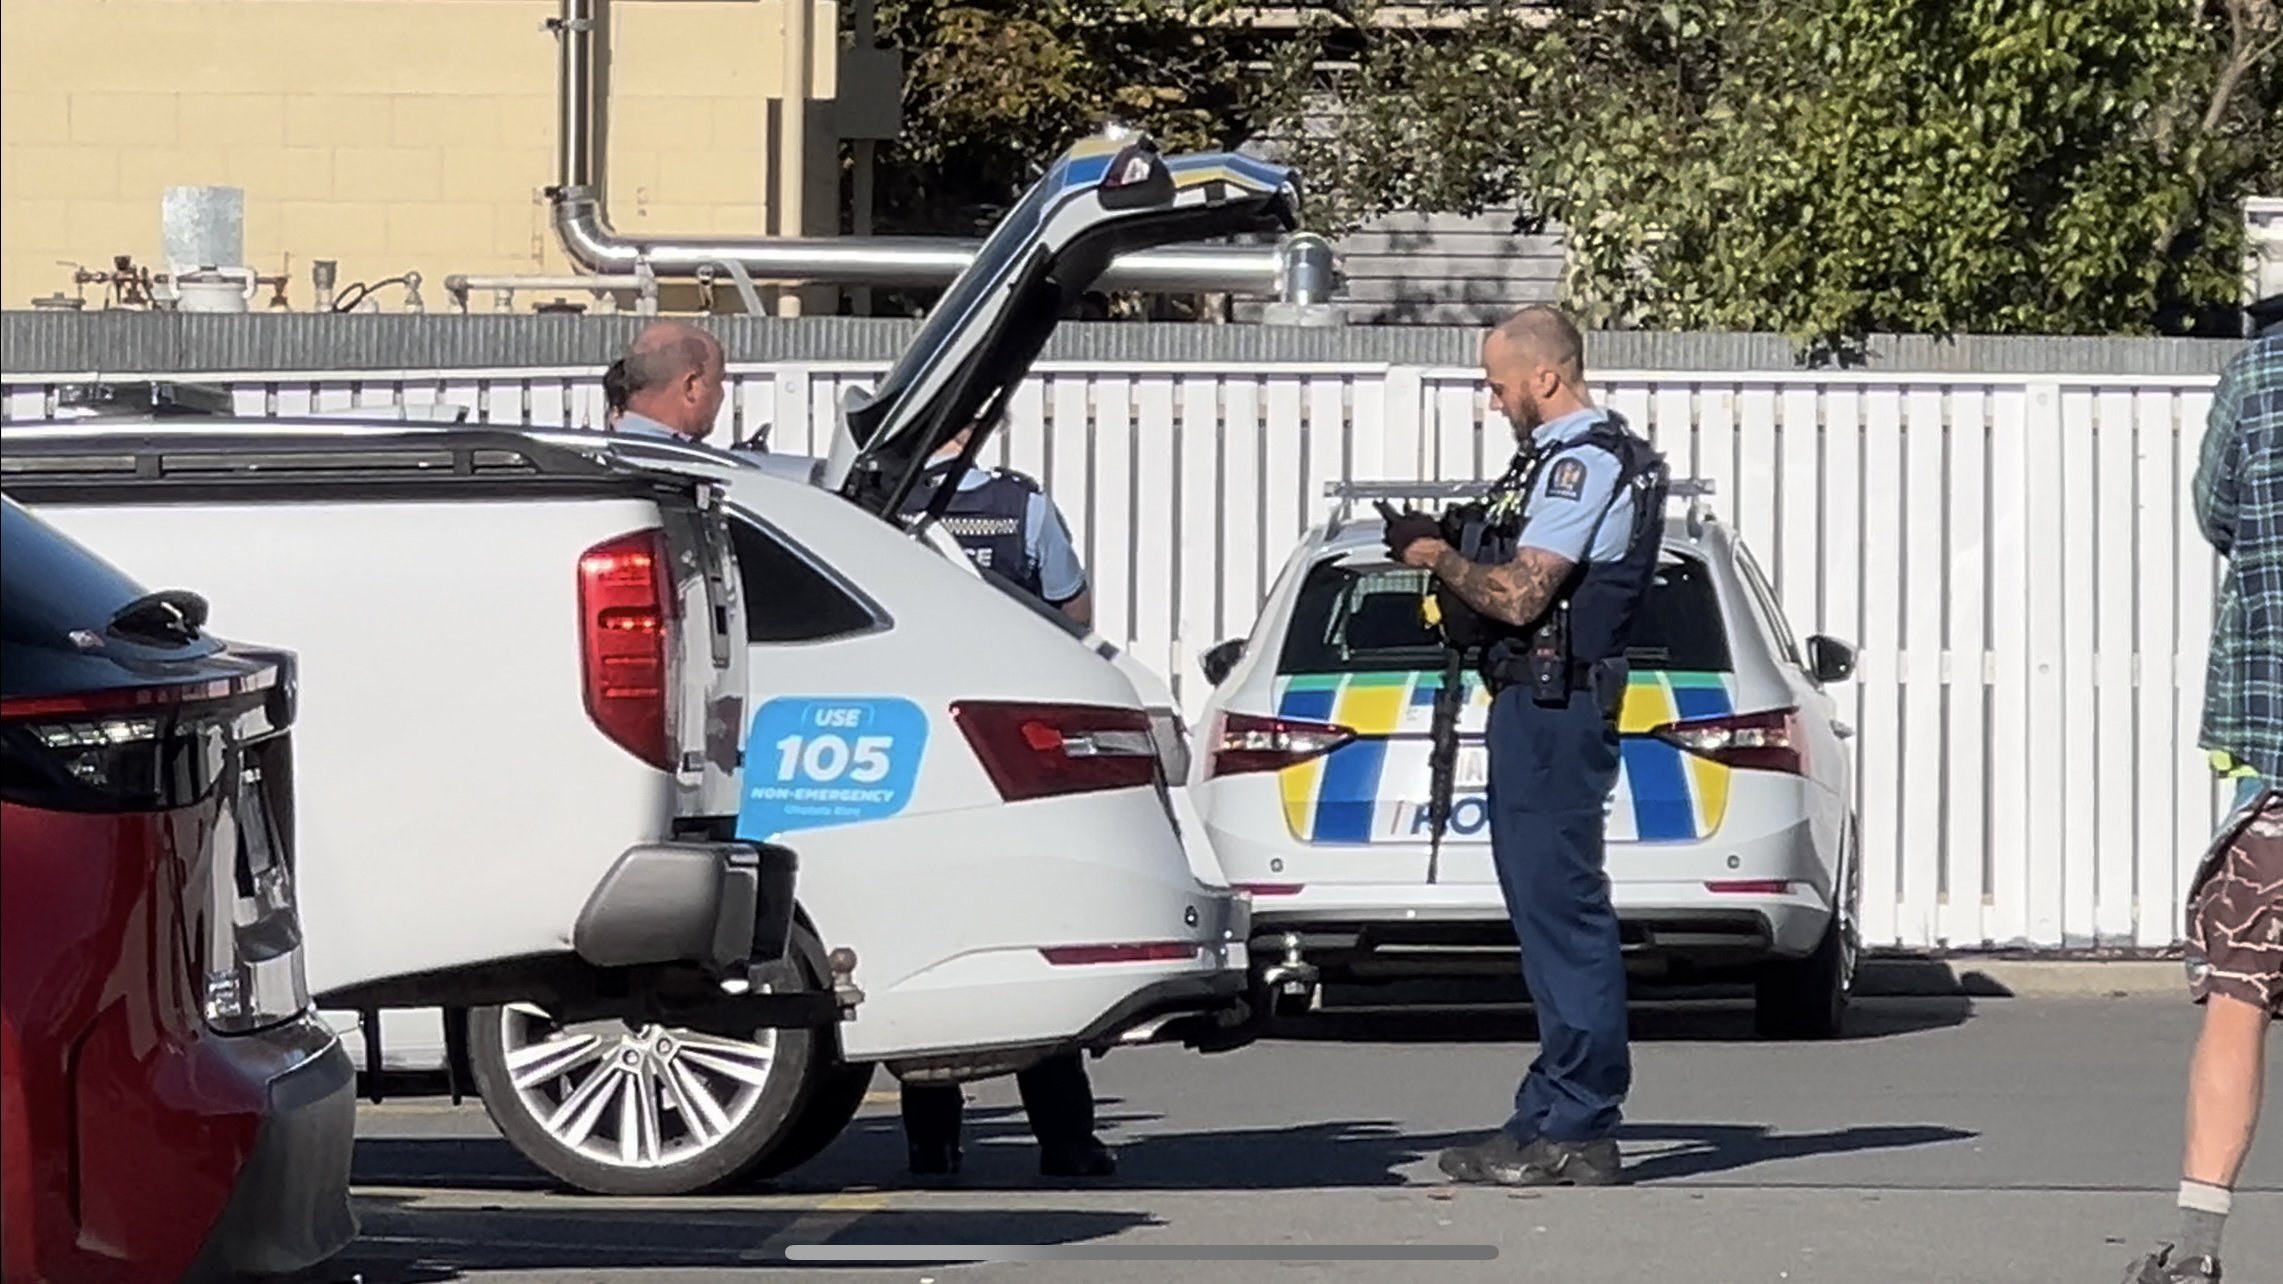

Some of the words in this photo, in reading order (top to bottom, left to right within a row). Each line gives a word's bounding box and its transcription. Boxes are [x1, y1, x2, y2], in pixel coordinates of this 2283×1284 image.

[815, 708, 862, 727] USE
[776, 734, 894, 783] 105
[751, 787, 895, 803] NON-EMERGENCY
